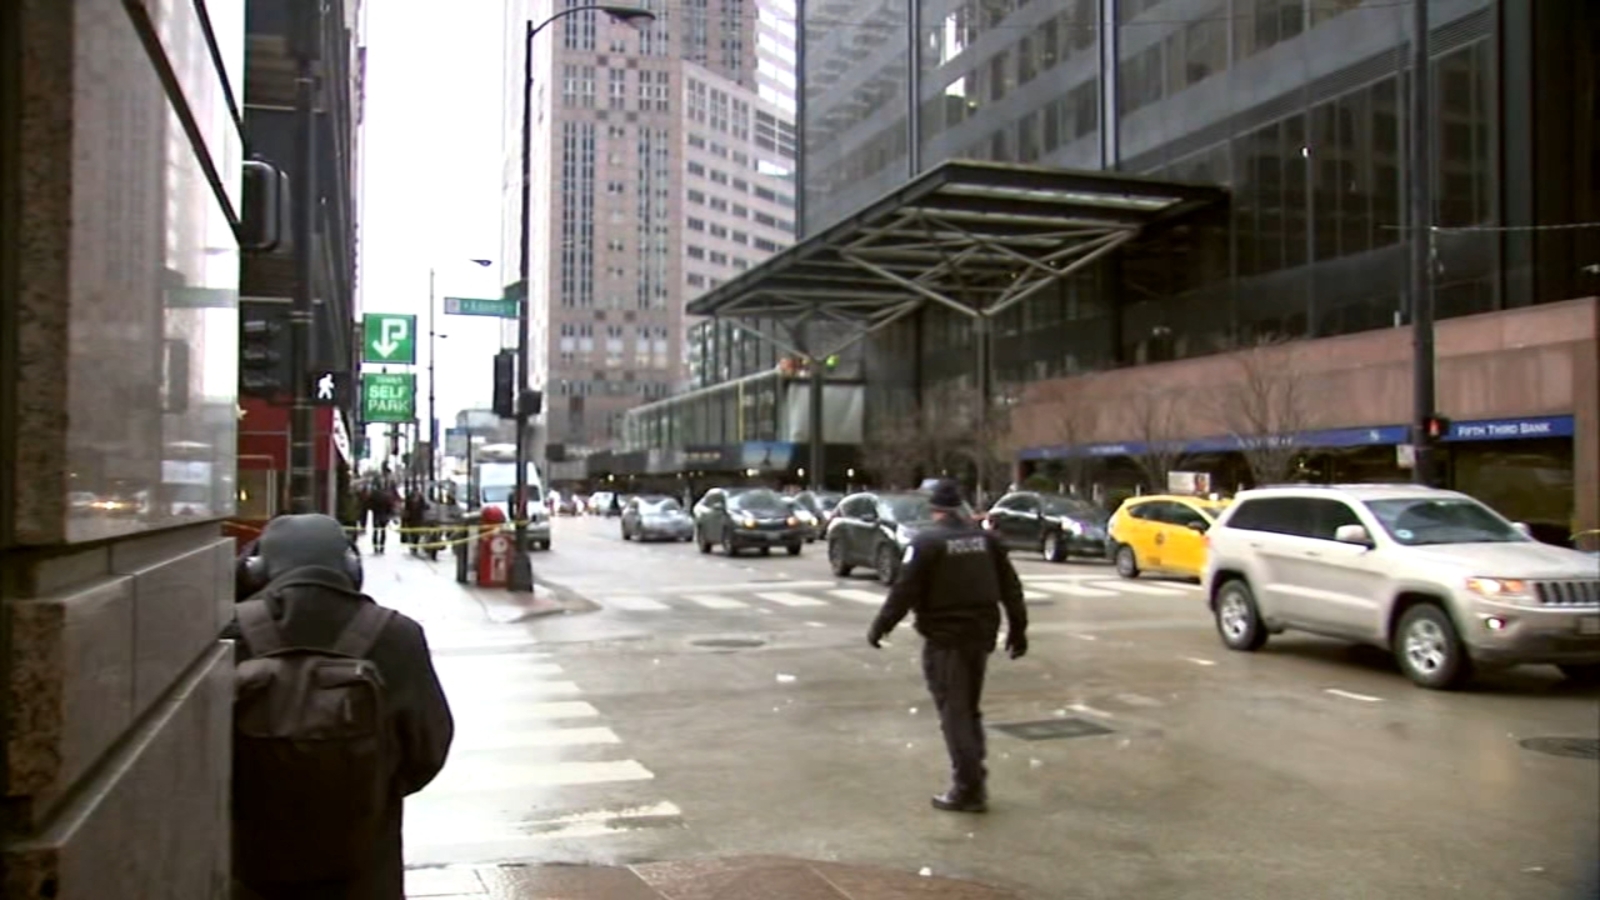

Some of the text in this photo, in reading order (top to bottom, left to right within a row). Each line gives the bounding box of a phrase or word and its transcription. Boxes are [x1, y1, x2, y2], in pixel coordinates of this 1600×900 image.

[369, 385, 407, 399] SELF
[368, 399, 409, 412] PARK
[1458, 422, 1550, 436] FIFTH THIRD BANK
[946, 537, 986, 554] POLICE
